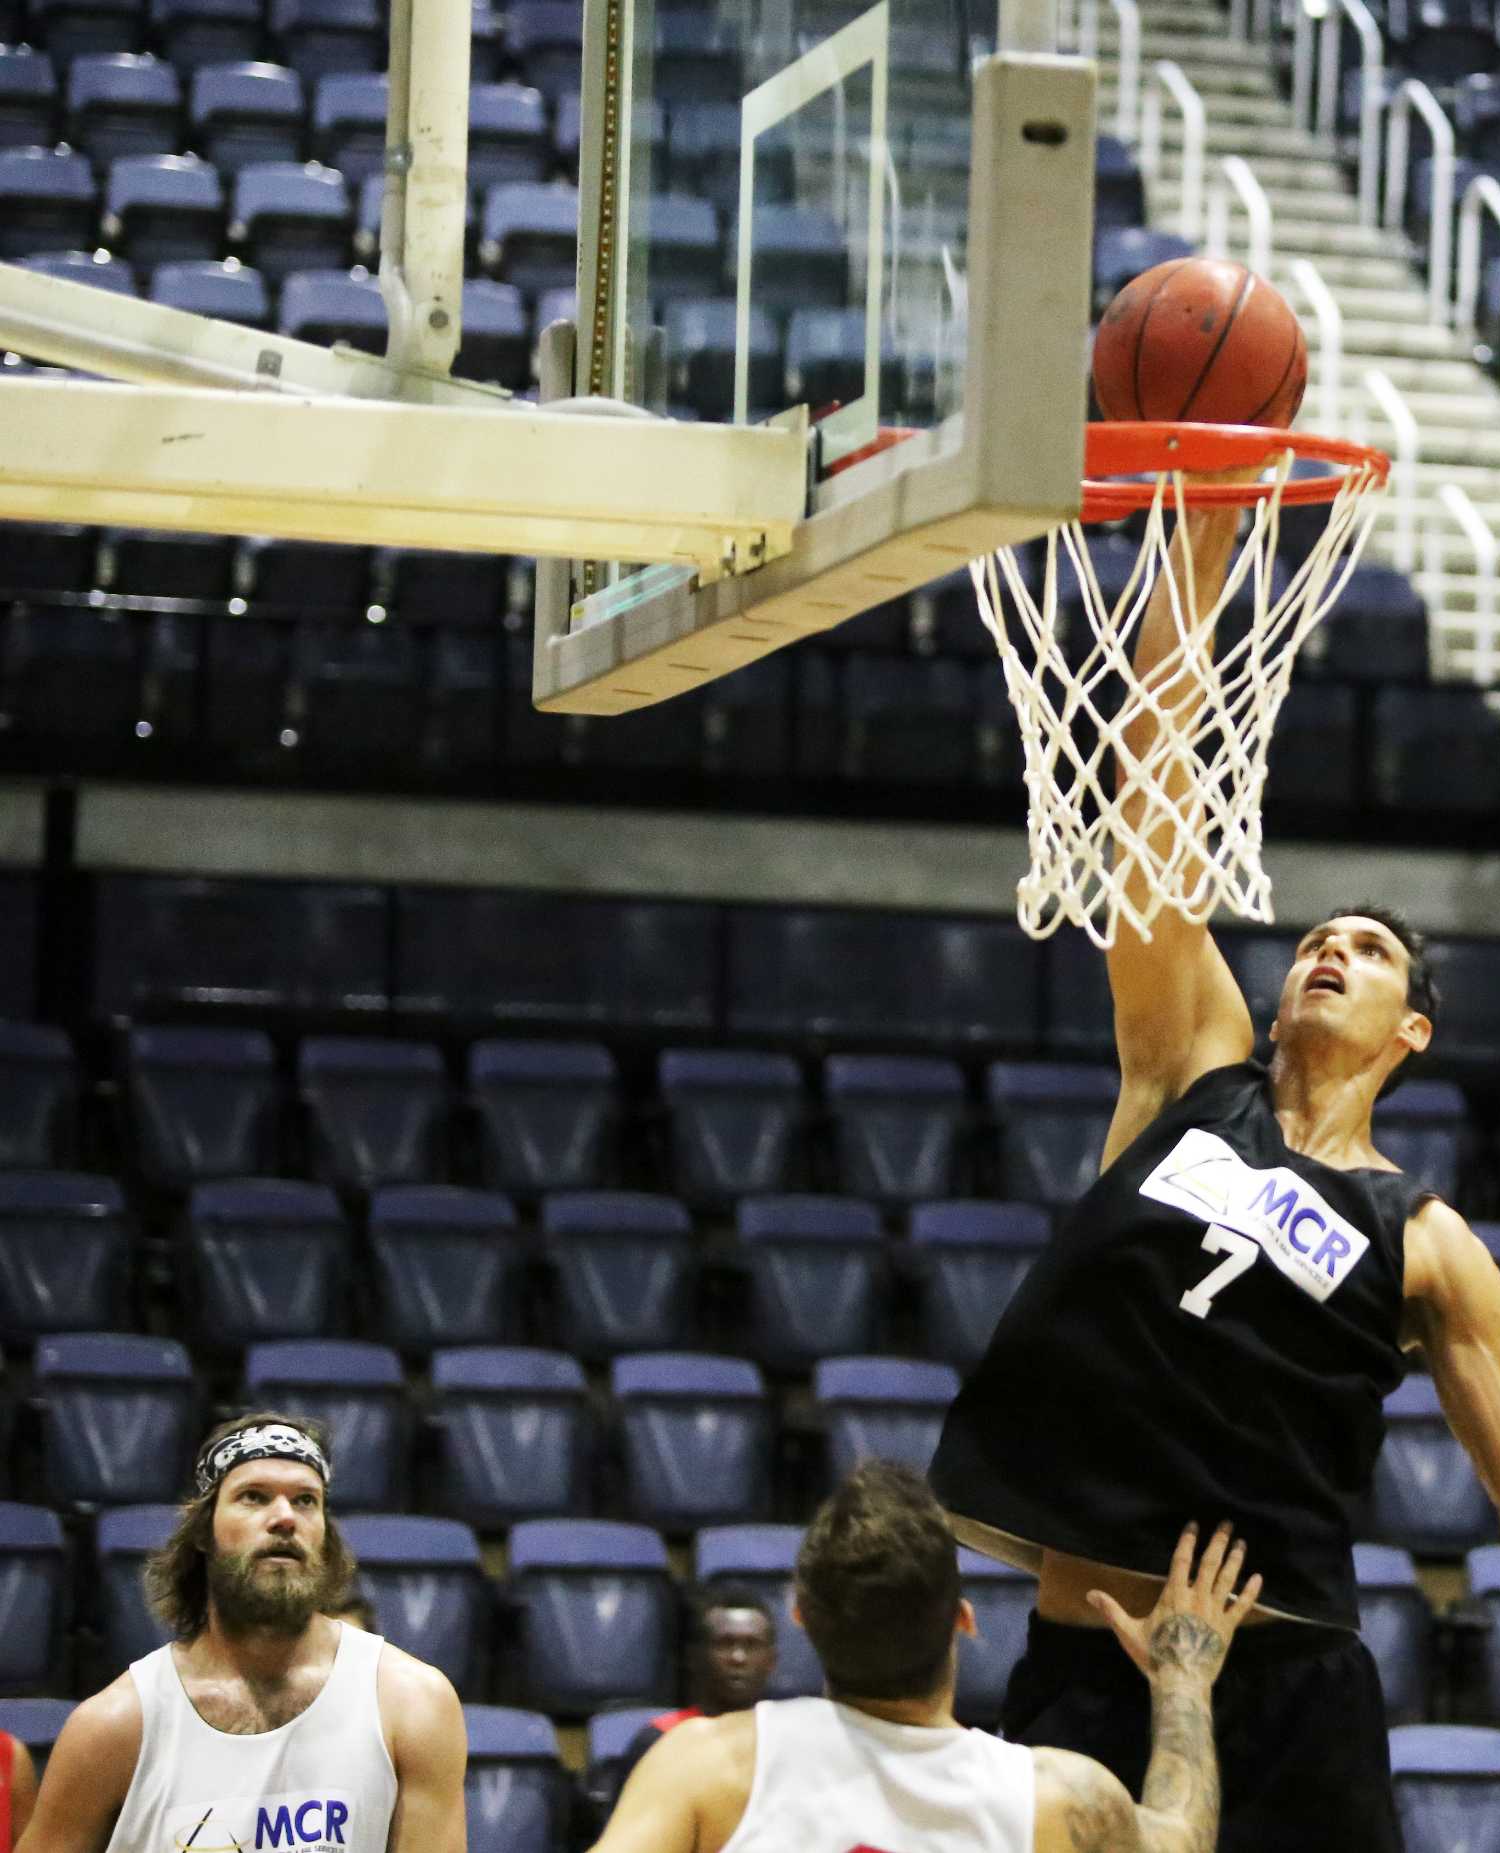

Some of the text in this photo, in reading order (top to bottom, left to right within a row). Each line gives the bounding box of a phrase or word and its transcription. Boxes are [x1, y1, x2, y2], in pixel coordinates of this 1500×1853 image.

[1179, 1222, 1260, 1319] 7
[1247, 1178, 1351, 1278] MCR
[255, 1800, 349, 1849] MCR
